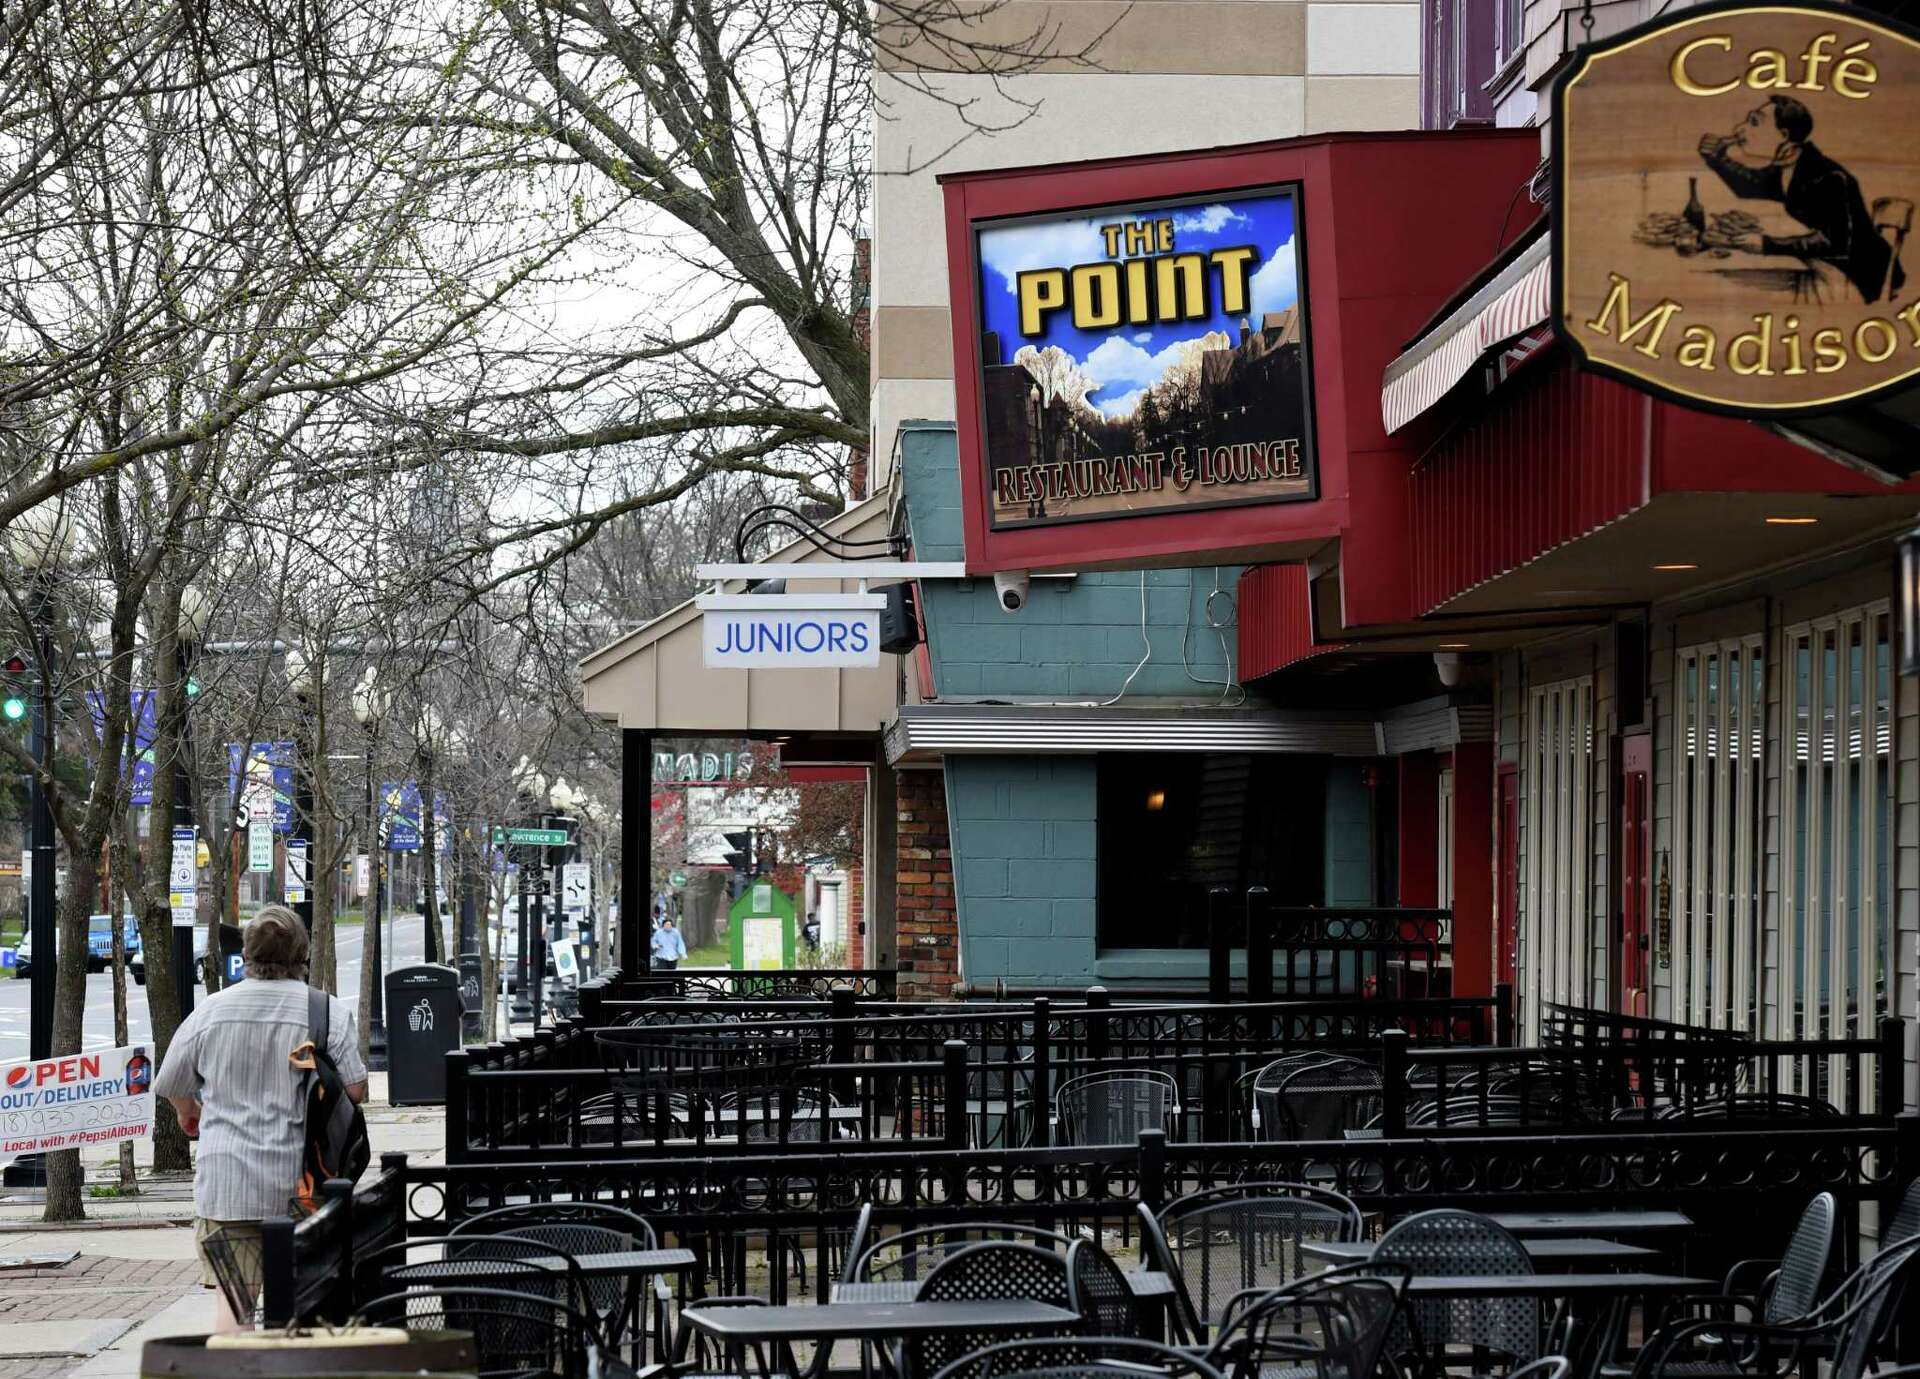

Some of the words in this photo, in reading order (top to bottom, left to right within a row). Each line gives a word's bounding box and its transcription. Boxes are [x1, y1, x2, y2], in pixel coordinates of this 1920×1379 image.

[1669, 33, 1879, 99] Café
[1100, 217, 1176, 258] THE
[1016, 245, 1258, 338] POINT
[995, 452, 1165, 505] RESTAURANT
[1171, 446, 1195, 492] &
[1198, 439, 1301, 485] LOUNGE
[716, 622, 869, 653] JUNIORS
[654, 752, 756, 781] MADIS
[511, 832, 551, 842] awrence
[231, 955, 244, 976] P
[1, 1078, 124, 1109] OUT/DELIVERY
[4, 1138, 36, 1152] Local
[40, 1135, 65, 1147] with
[69, 1123, 148, 1144] #PepsiAlbany
